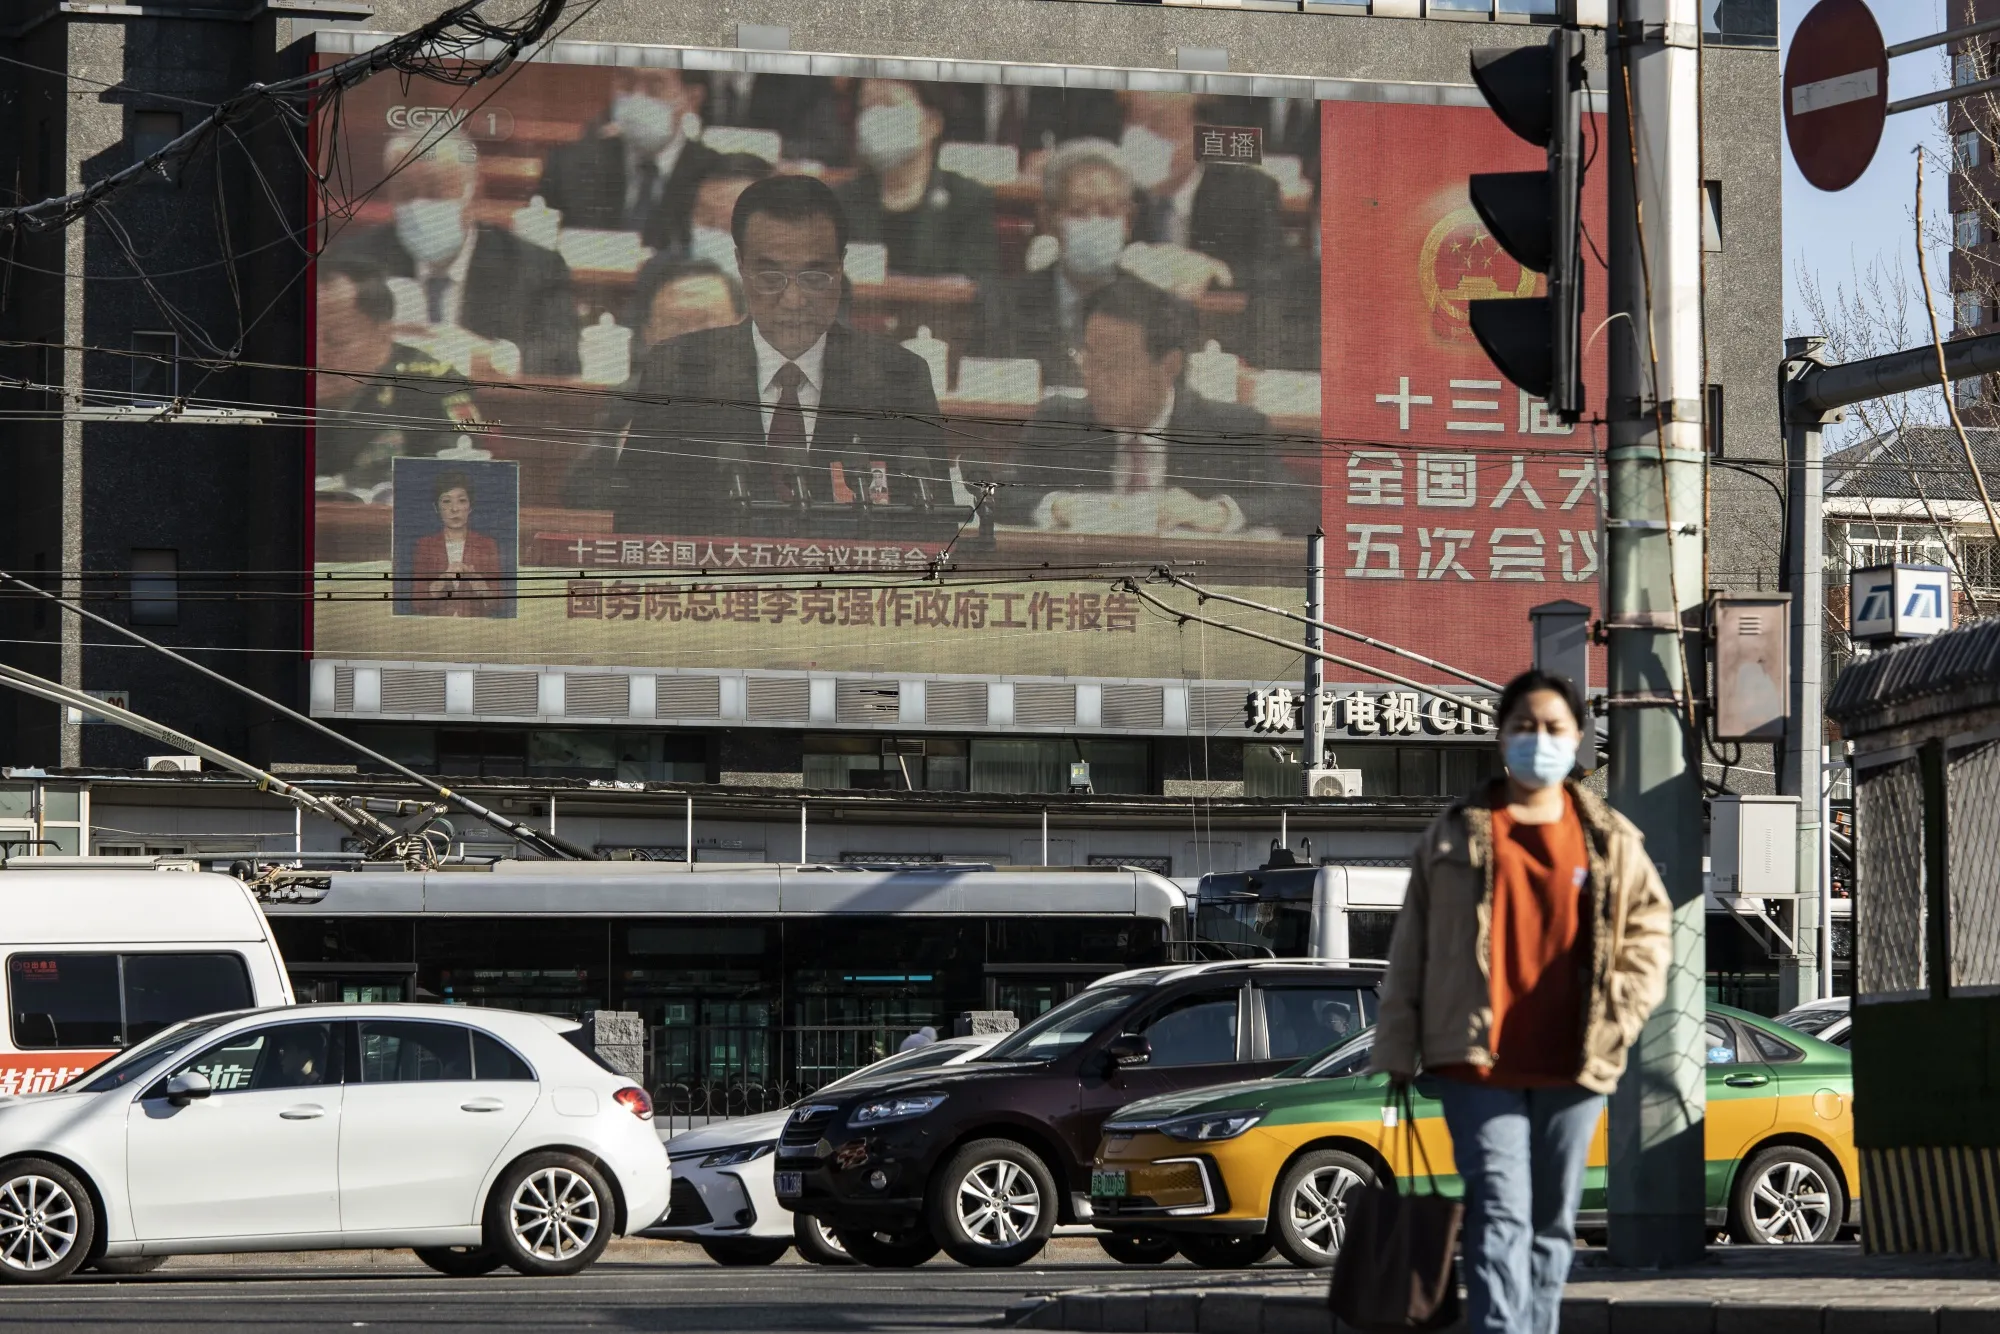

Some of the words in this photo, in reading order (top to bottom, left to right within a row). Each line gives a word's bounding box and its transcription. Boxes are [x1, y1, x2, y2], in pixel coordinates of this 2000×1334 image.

[386, 105, 469, 131] CCTV
[486, 112, 496, 135] 1
[1202, 130, 1255, 159] 直播
[1347, 450, 1608, 510] 全国人大
[567, 538, 928, 571] 十三届全国人大五次会议开幕会
[567, 580, 1141, 633] 国务院总理李克强作政府工作报告
